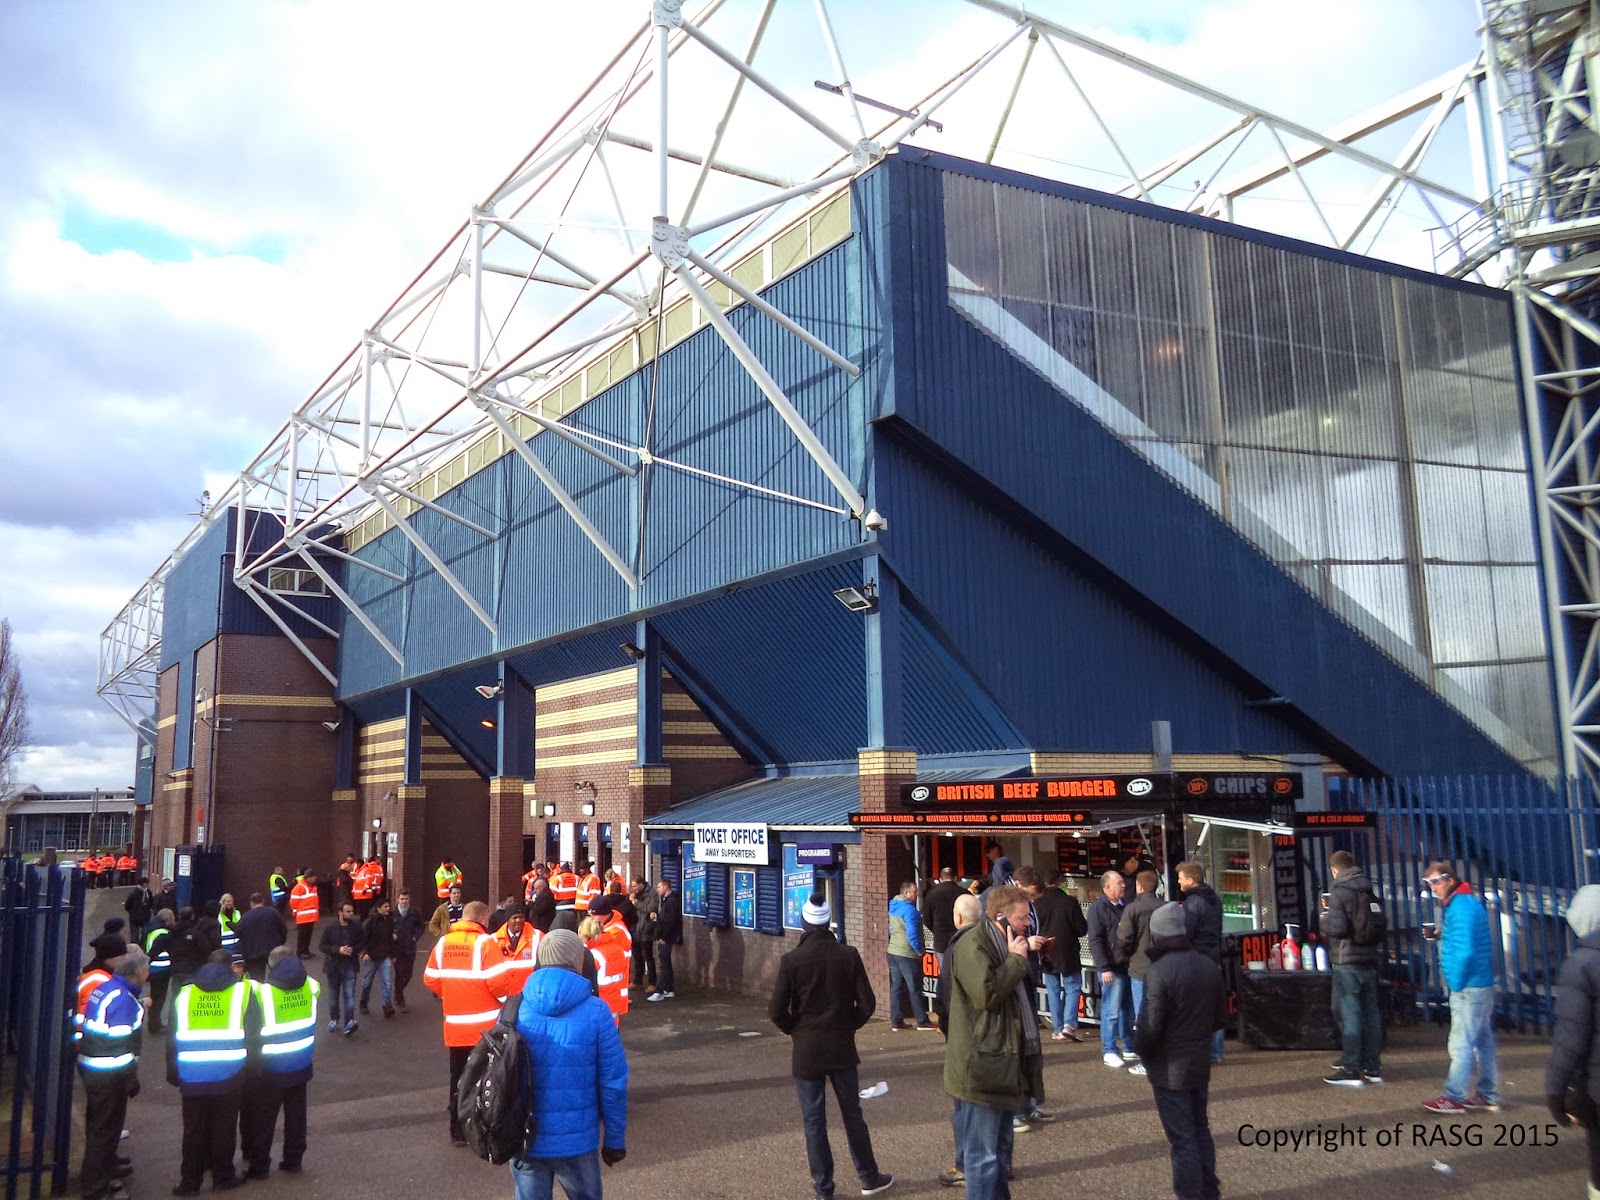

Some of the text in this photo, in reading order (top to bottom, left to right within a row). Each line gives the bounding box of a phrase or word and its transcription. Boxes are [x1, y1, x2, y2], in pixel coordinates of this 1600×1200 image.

[937, 779, 1116, 800] BRITISH BEEF BURGER
[1129, 781, 1150, 793] 100%
[1214, 777, 1267, 794] CHIPS
[1306, 815, 1319, 823] HOT
[1327, 815, 1342, 823] COLD
[697, 828, 764, 845] TICKET OFFICE
[705, 848, 756, 859] AWAY SUPPORTERS
[798, 849, 831, 857] PROGRAMMES
[199, 994, 221, 1002] SPURS
[283, 993, 304, 1003] TRAVEL
[280, 1000, 308, 1011] STEWARD
[192, 1009, 225, 1017] STEWARD
